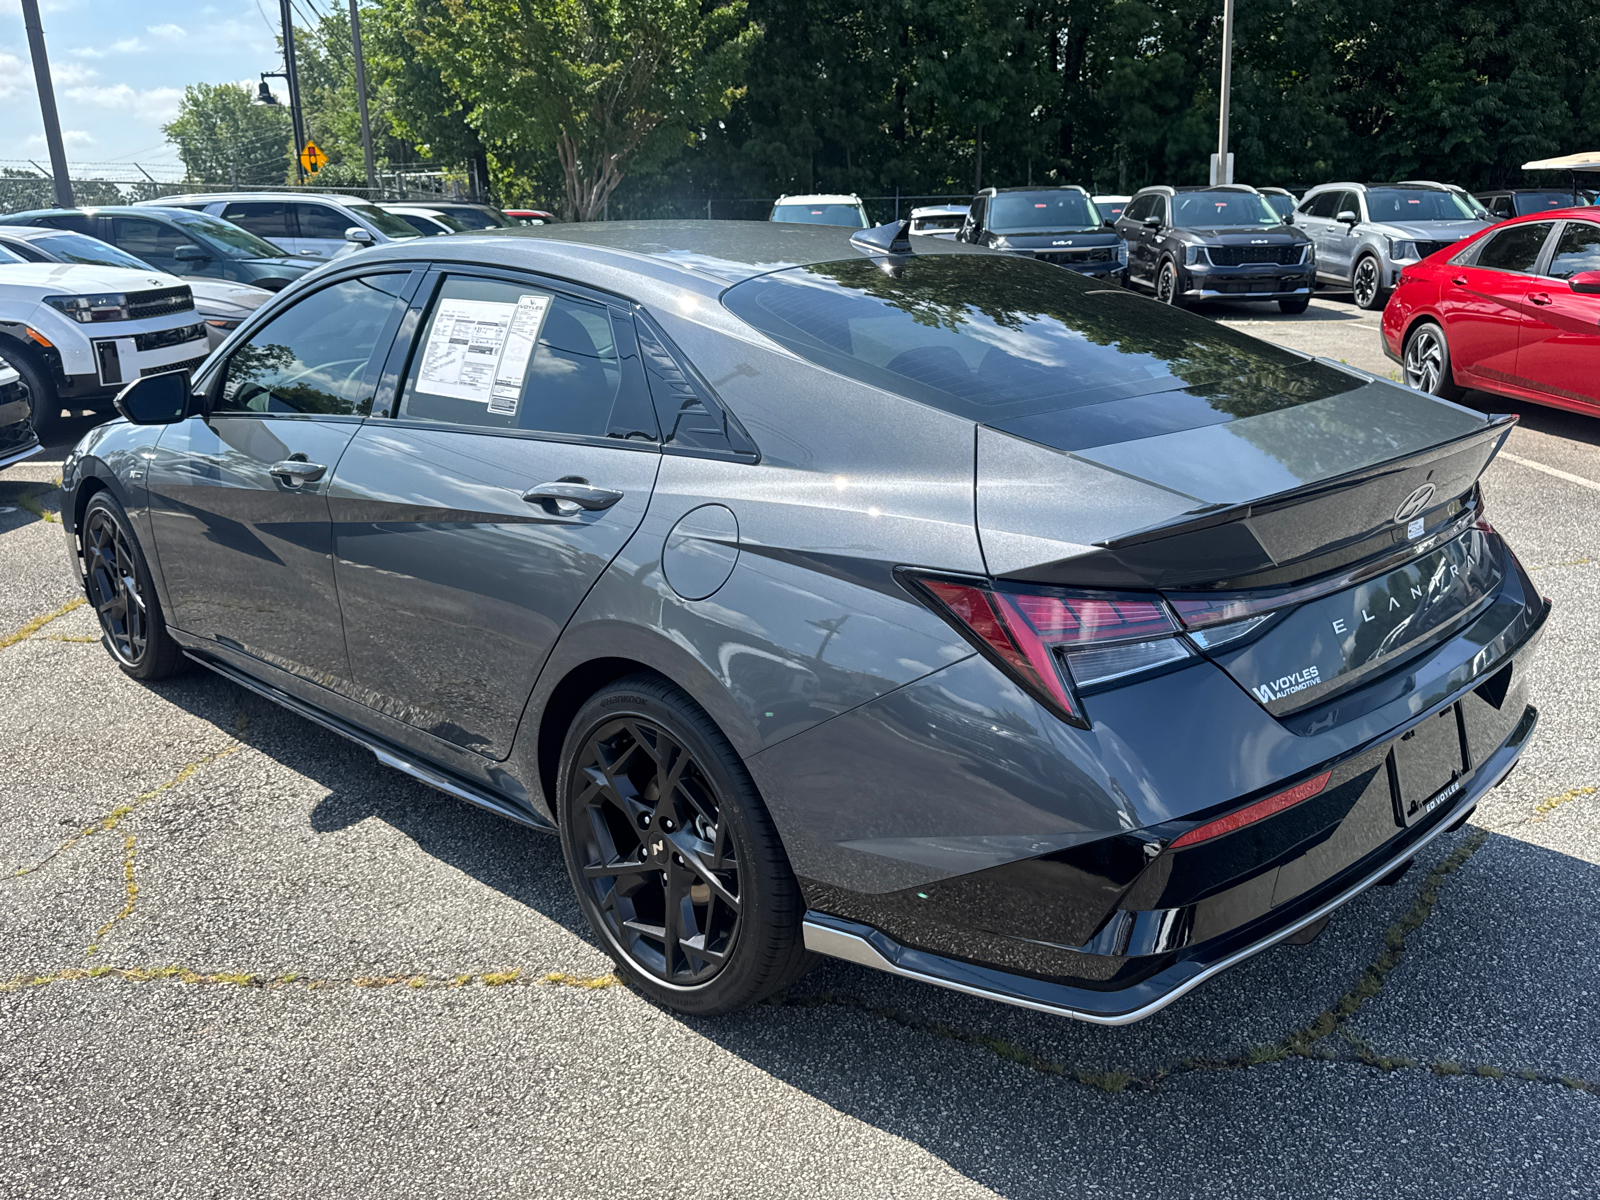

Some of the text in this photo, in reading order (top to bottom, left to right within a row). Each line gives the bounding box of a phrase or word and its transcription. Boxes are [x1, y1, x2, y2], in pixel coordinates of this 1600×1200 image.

[1332, 553, 1475, 634] ELANTRA
[1270, 665, 1319, 691] VOYLES
[1276, 676, 1321, 699] AUTOMOTIVE
[1426, 782, 1460, 813] ED VOYLES
